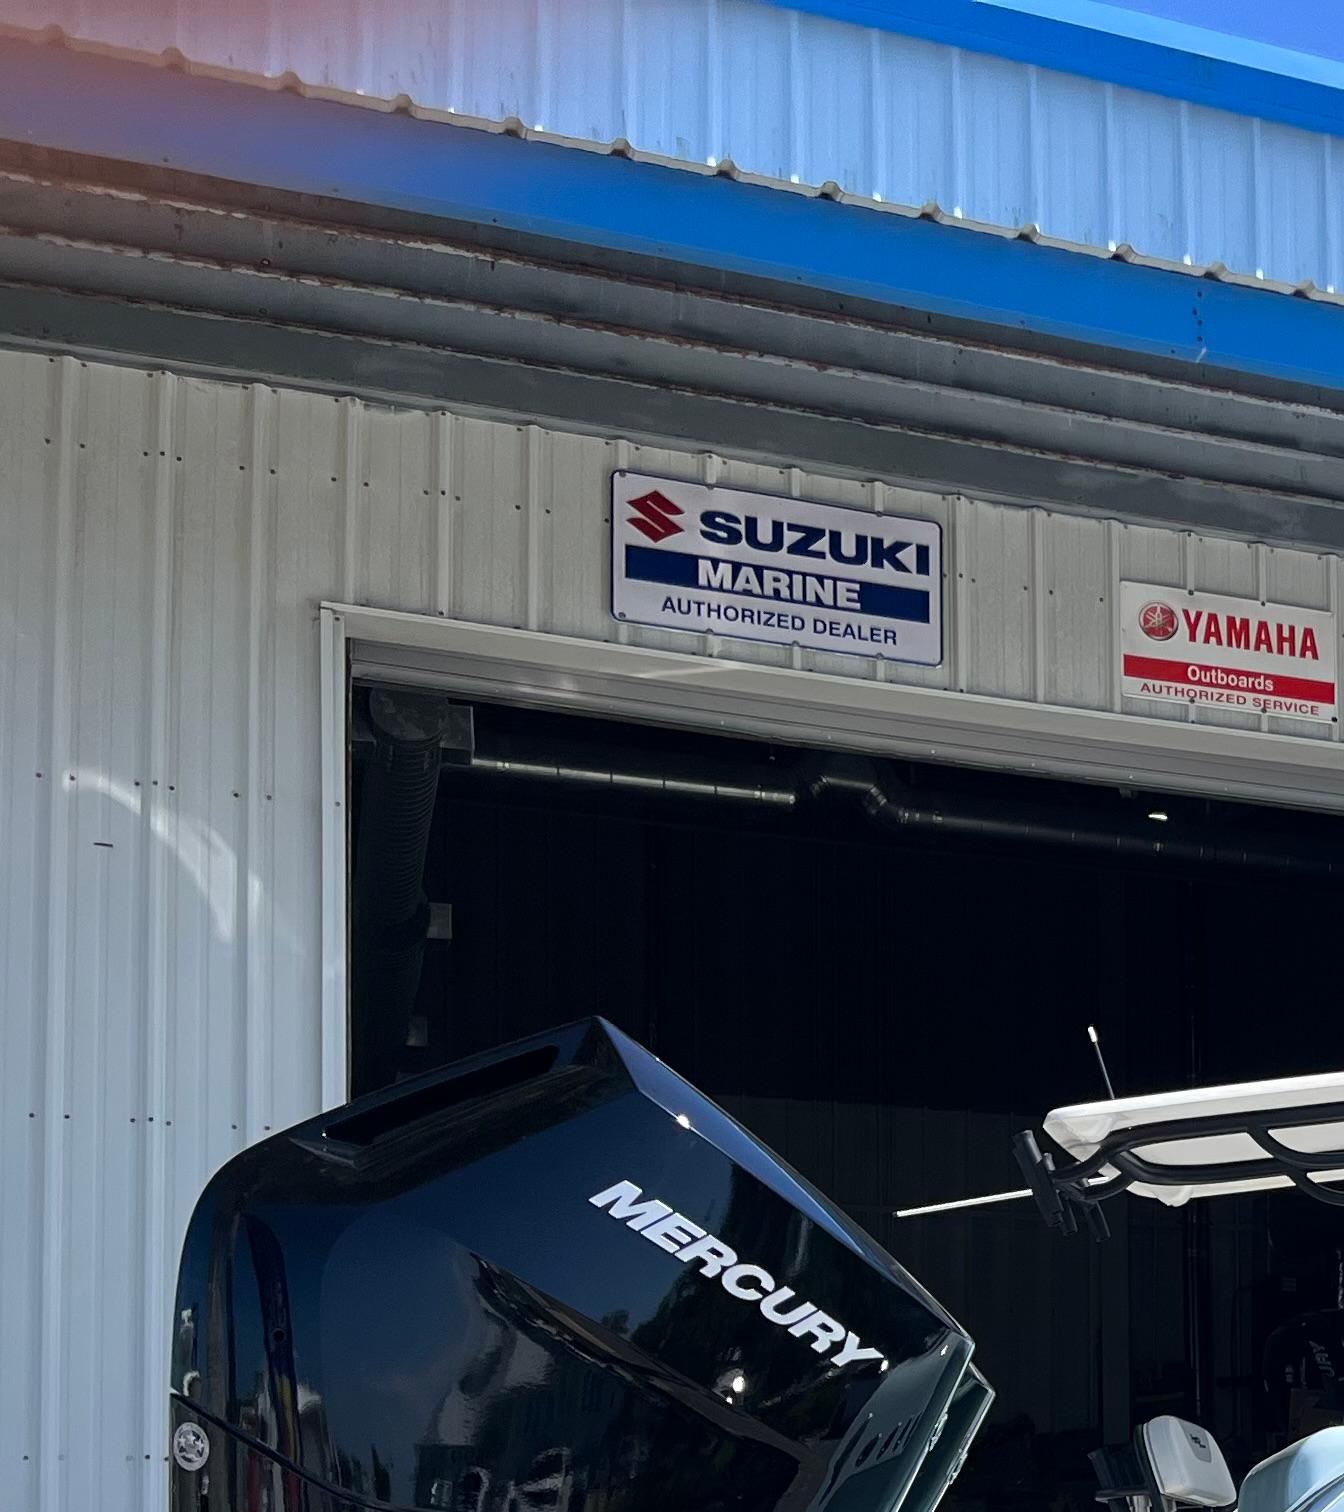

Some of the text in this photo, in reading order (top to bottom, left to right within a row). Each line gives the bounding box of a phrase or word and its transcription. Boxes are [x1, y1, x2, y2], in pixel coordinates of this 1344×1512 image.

[699, 510, 930, 576] SUZUKI
[697, 558, 862, 611] MARINE
[661, 596, 897, 646] AUTHORIZED DEALER
[1182, 607, 1320, 661] YAMAHA
[1140, 682, 1320, 716] AUTHORIZED SERVICE
[1187, 665, 1274, 692] Outboards
[588, 1179, 885, 1368] MERCURY
